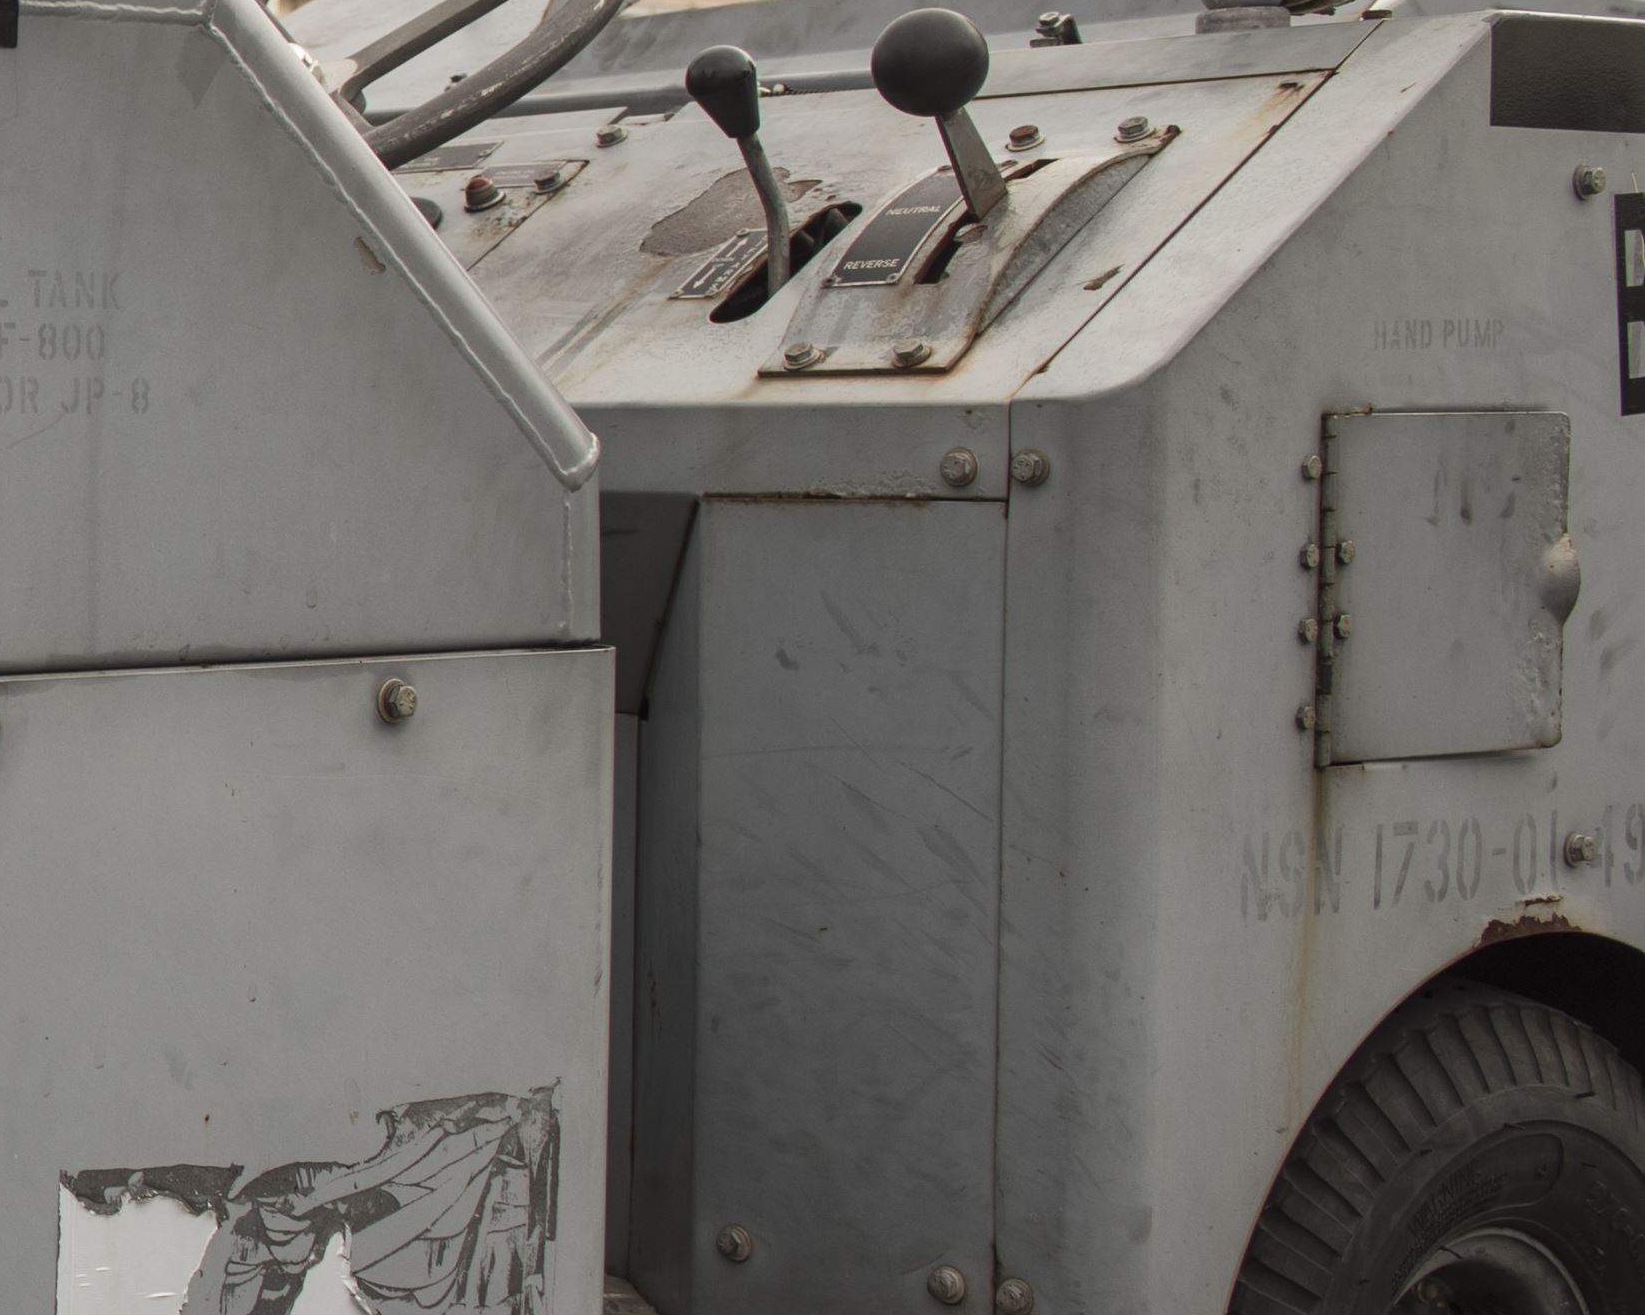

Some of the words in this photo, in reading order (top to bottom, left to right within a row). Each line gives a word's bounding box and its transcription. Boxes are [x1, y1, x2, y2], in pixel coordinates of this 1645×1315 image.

[885, 204, 942, 217] NEUTRAL
[842, 257, 901, 271] REVERSE
[27, 268, 121, 311] TANK
[1374, 318, 1433, 351] HAND
[1442, 317, 1505, 349] PUMP
[61, 376, 151, 416] JP-8
[1240, 825, 1343, 923] NSN
